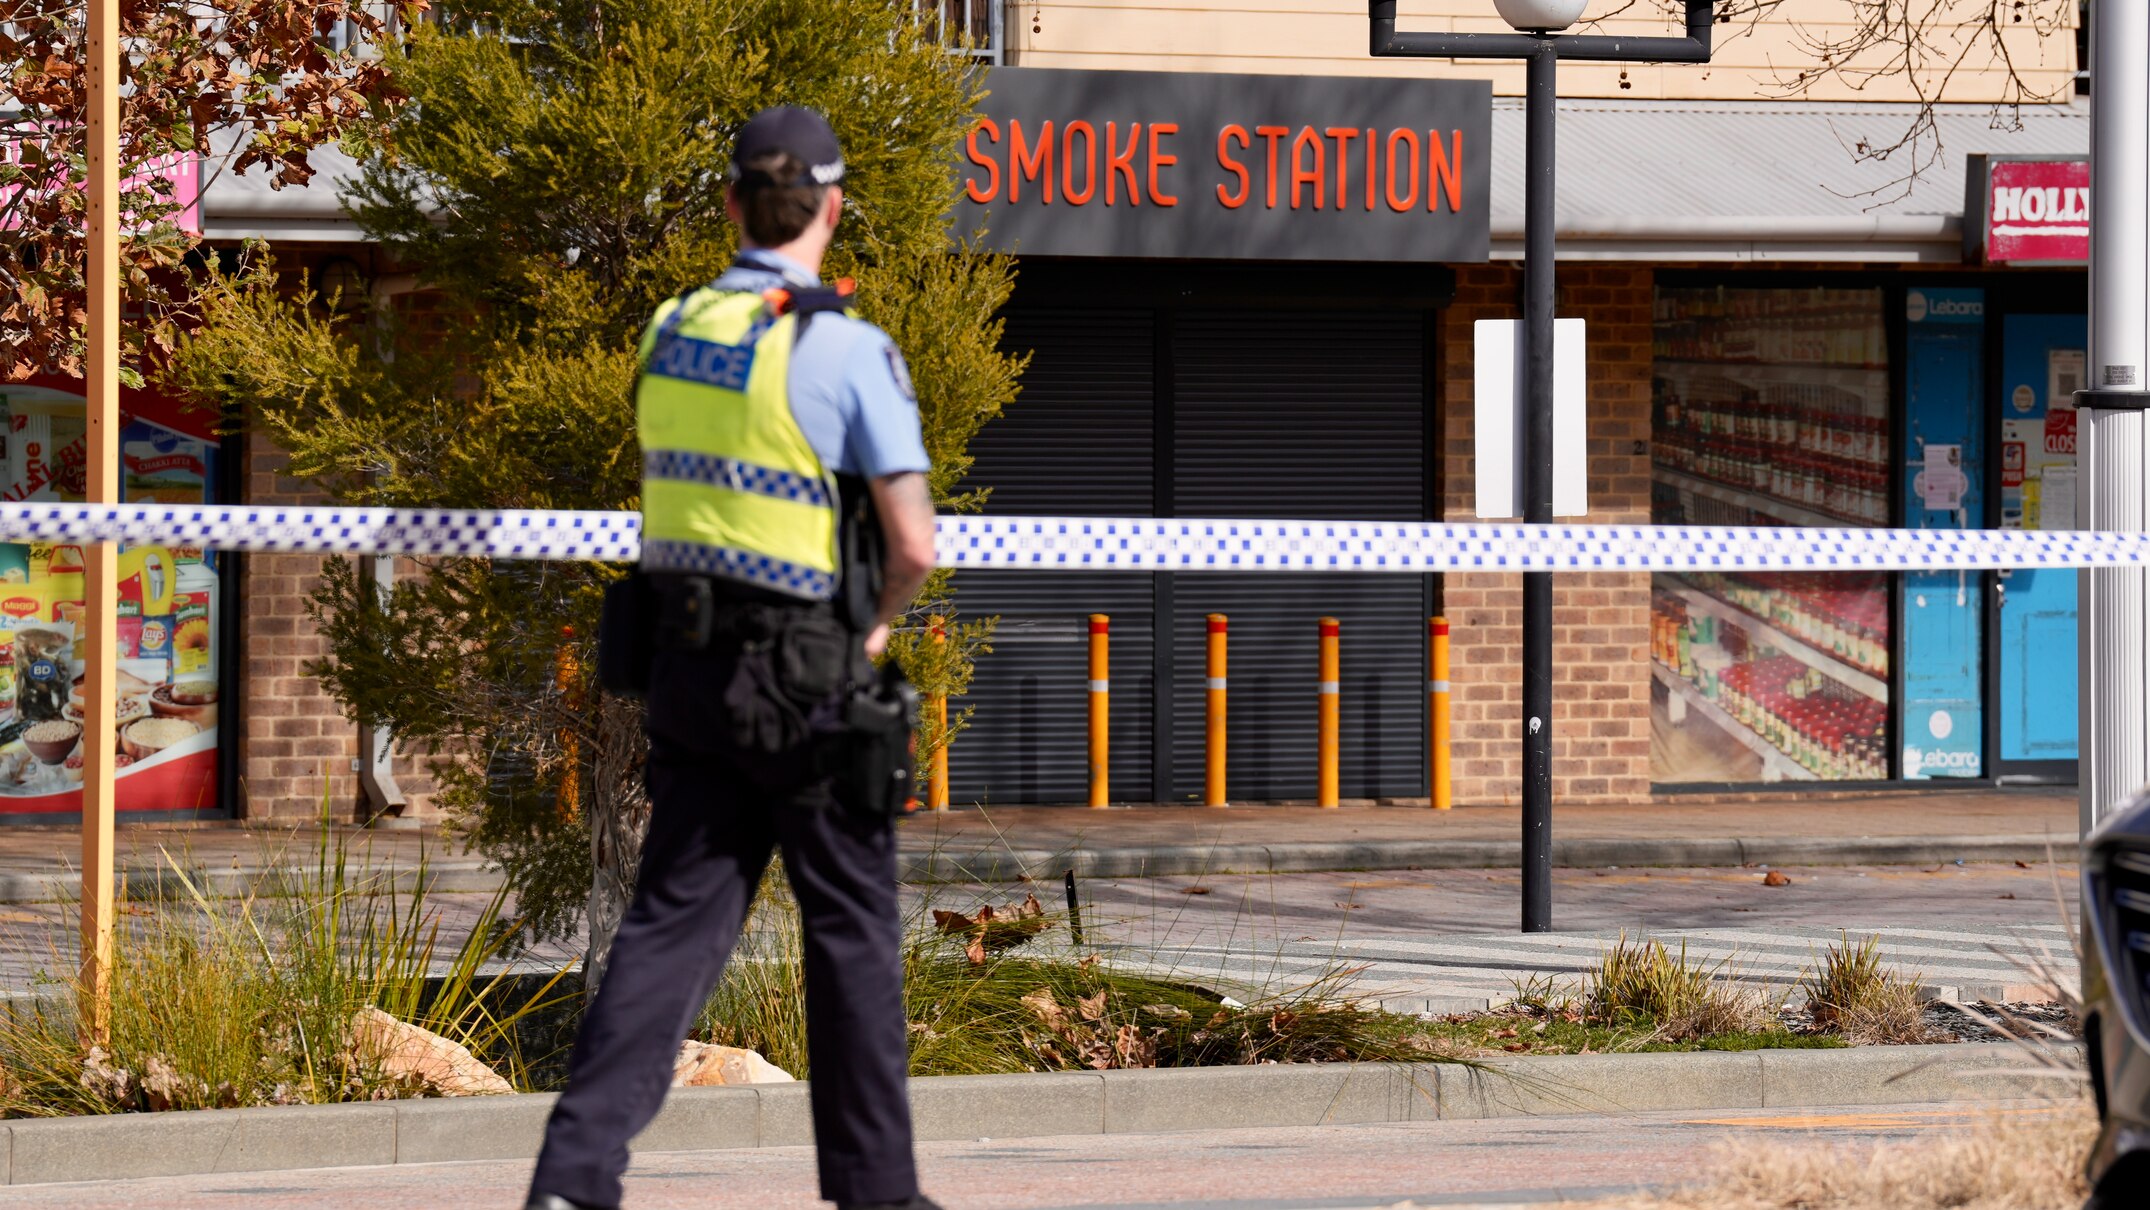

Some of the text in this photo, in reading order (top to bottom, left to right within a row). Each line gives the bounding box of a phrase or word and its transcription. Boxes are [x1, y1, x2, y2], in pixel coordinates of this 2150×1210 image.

[966, 118, 1463, 213] SMOKE STATION
[1928, 298, 1984, 316] Lebara
[651, 337, 749, 387] POLICE
[33, 664, 53, 676] BD
